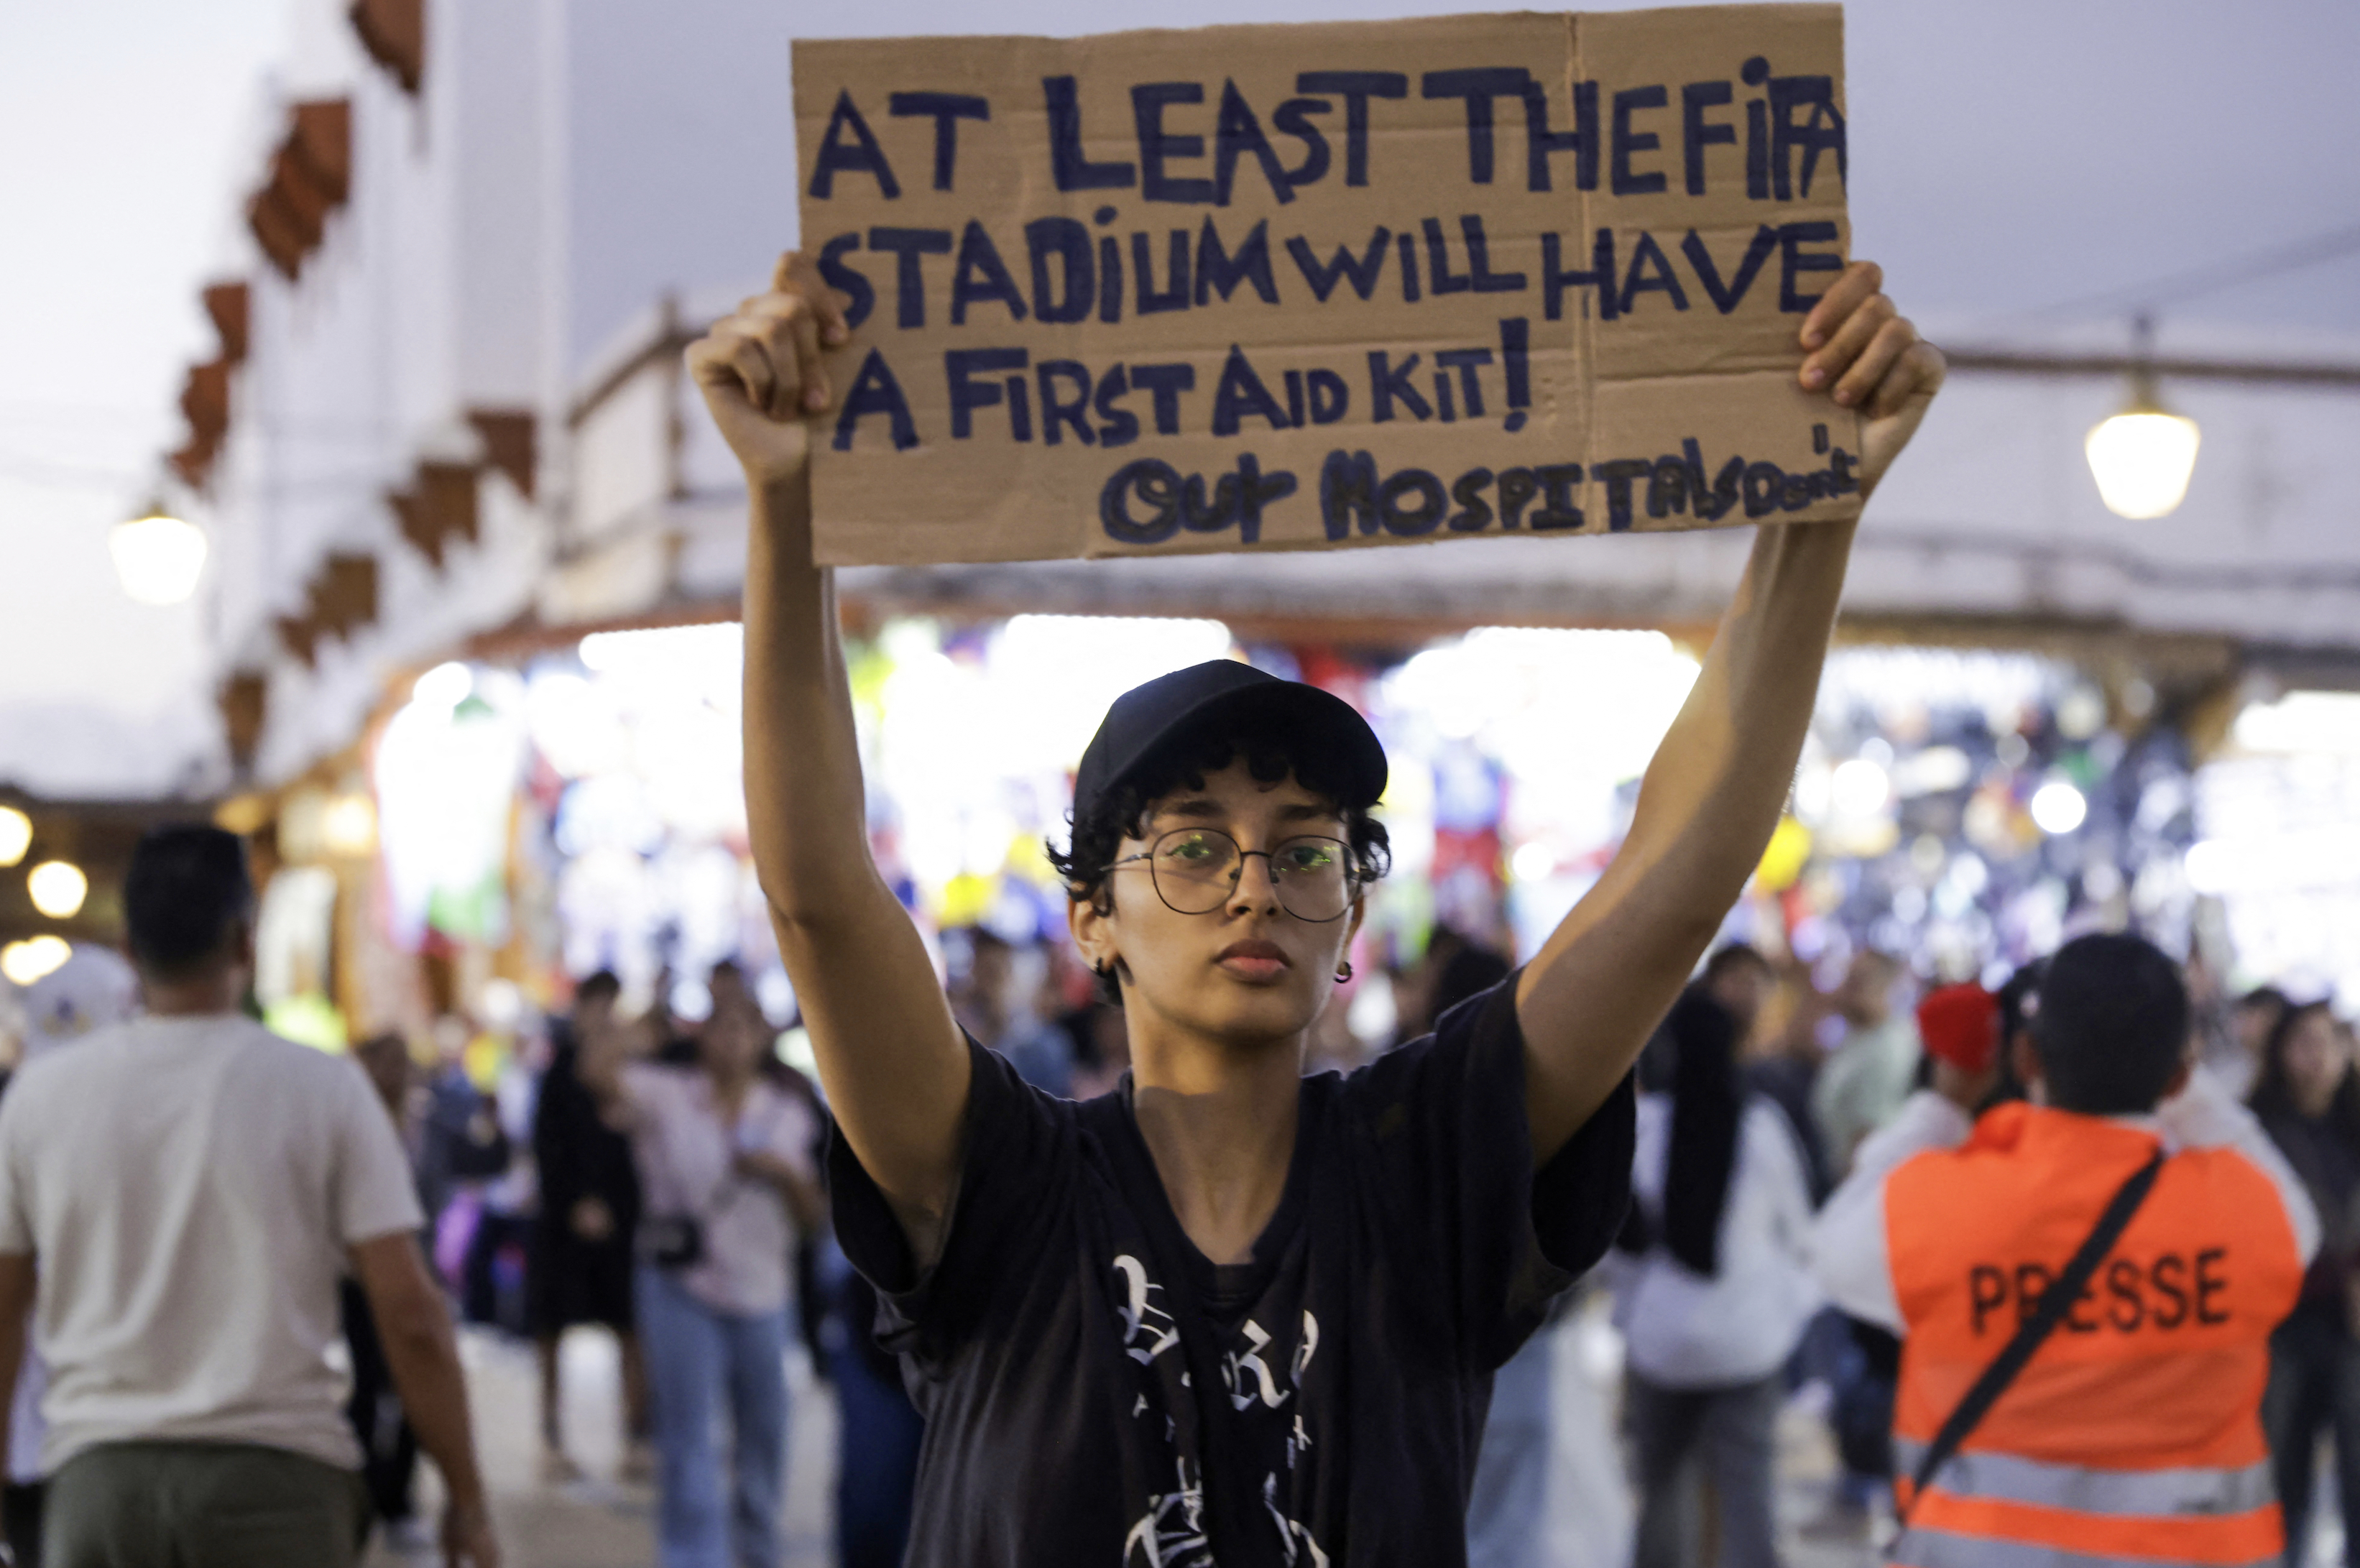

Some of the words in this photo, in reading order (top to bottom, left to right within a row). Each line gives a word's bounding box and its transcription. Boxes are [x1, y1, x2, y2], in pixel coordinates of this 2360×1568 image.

[808, 88, 990, 200] AT
[1042, 70, 1407, 207] LEAST
[1422, 68, 1667, 196] THE
[1285, 215, 1526, 303] WILL
[1541, 221, 1844, 320] HAVE
[832, 347, 920, 451] A
[1212, 343, 1350, 436] AID
